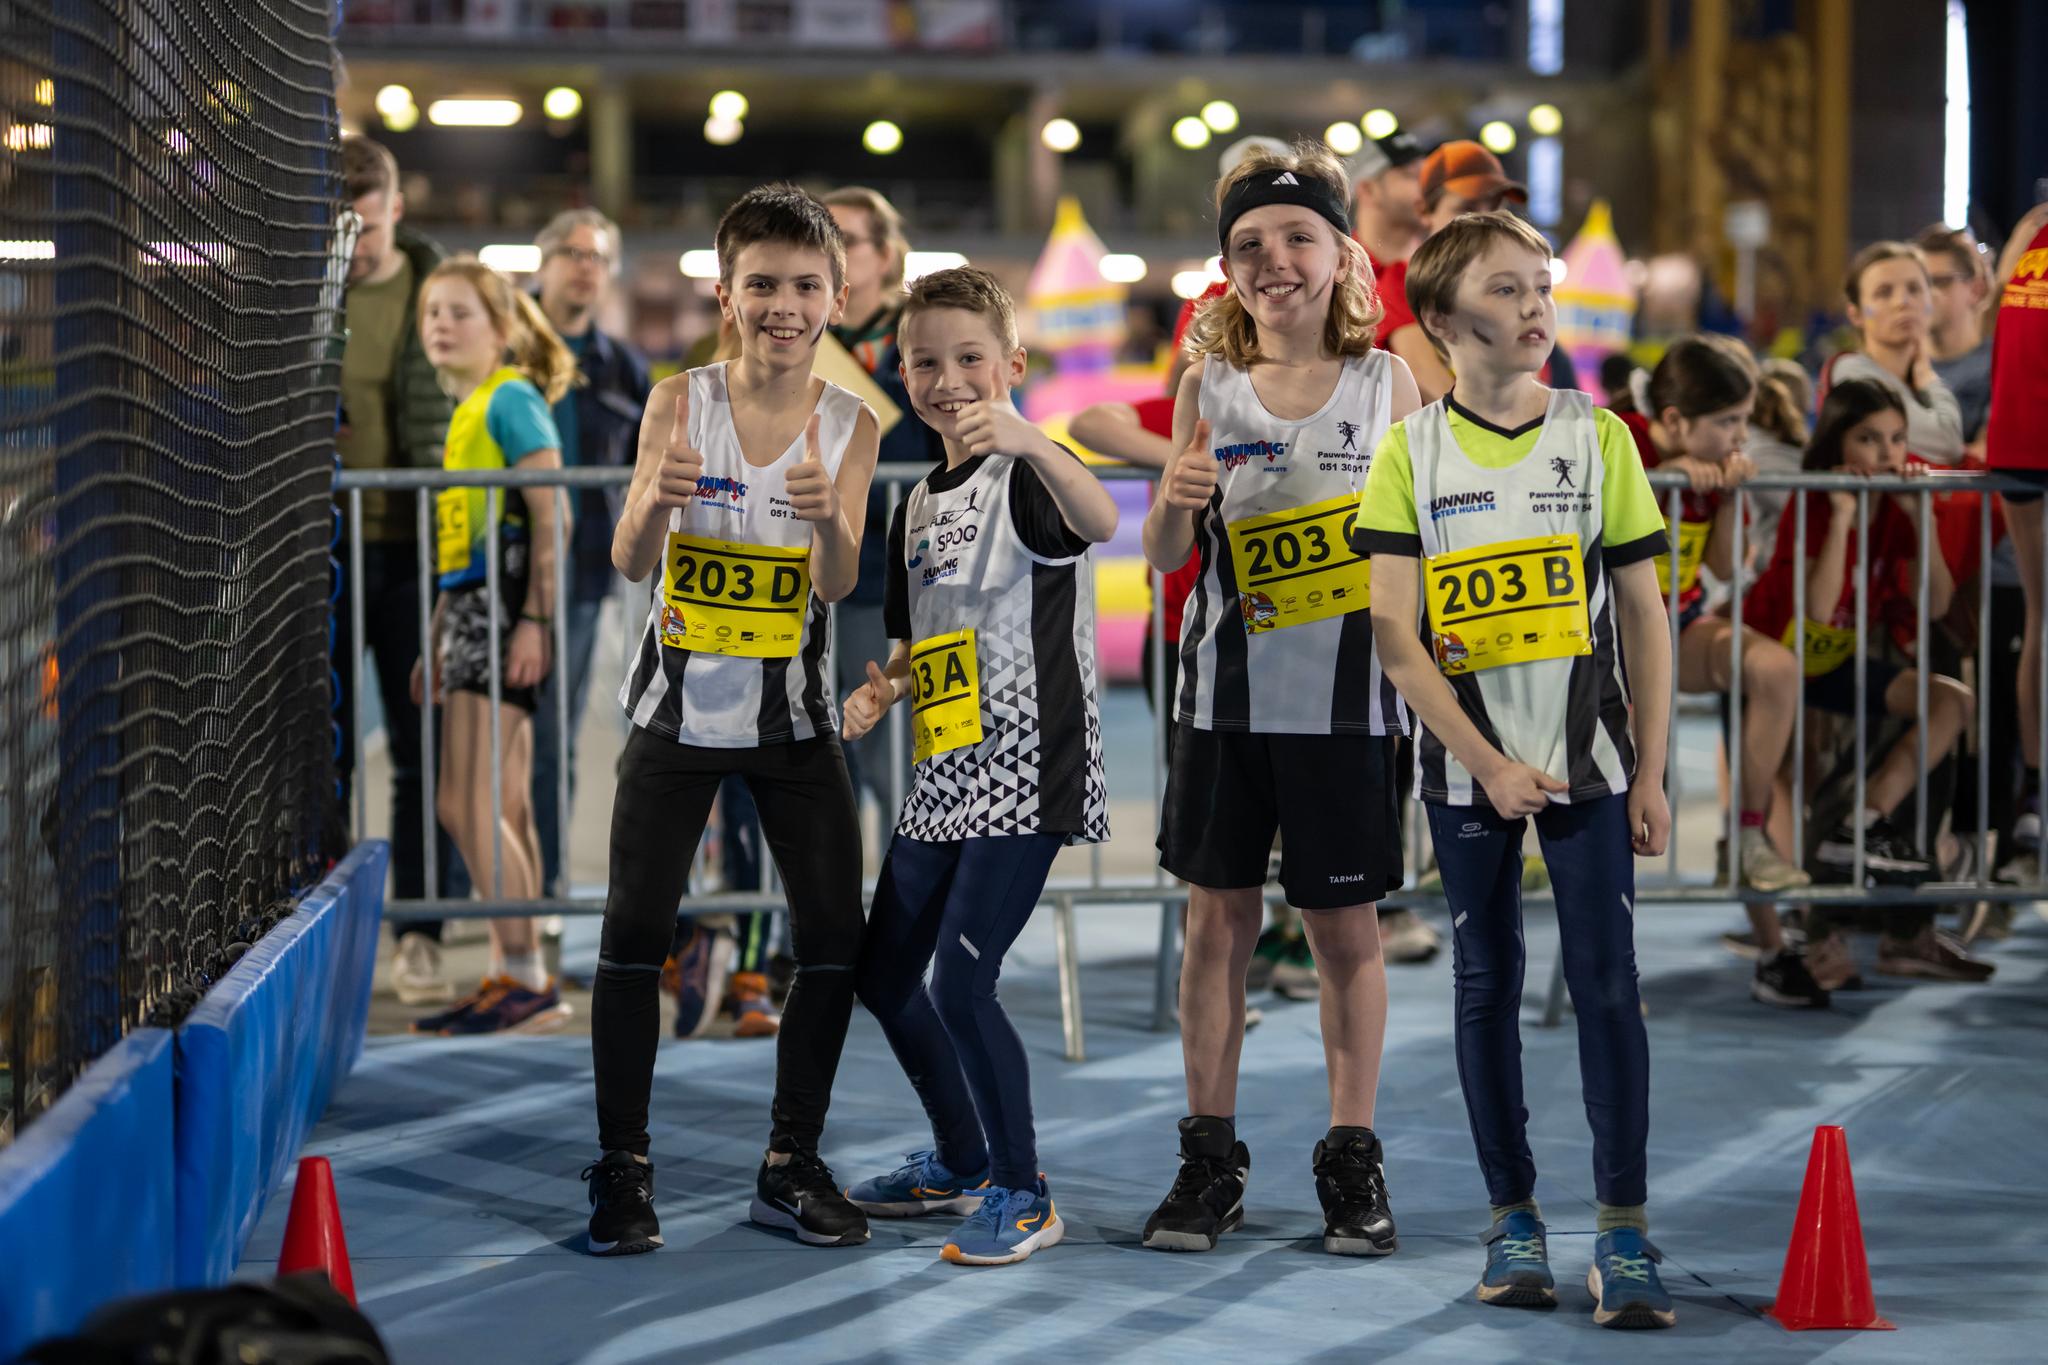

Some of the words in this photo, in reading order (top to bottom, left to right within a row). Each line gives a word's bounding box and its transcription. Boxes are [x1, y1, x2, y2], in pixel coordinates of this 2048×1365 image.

[1319, 462, 1337, 471] 051
[1529, 491, 1574, 500] Pauwelyn
[770, 509, 787, 518] 051
[1459, 503, 1497, 514] HULSTE
[1532, 504, 1552, 513] 051
[1556, 504, 1569, 513] 30
[937, 524, 978, 552] SPOQ
[1244, 525, 1330, 576] 203
[674, 555, 754, 601] 203
[770, 565, 801, 603] D
[1438, 563, 1527, 615] 203
[1543, 555, 1574, 597] B
[911, 661, 934, 704] 03
[943, 651, 970, 693] A
[1329, 873, 1365, 884] TARMAK
